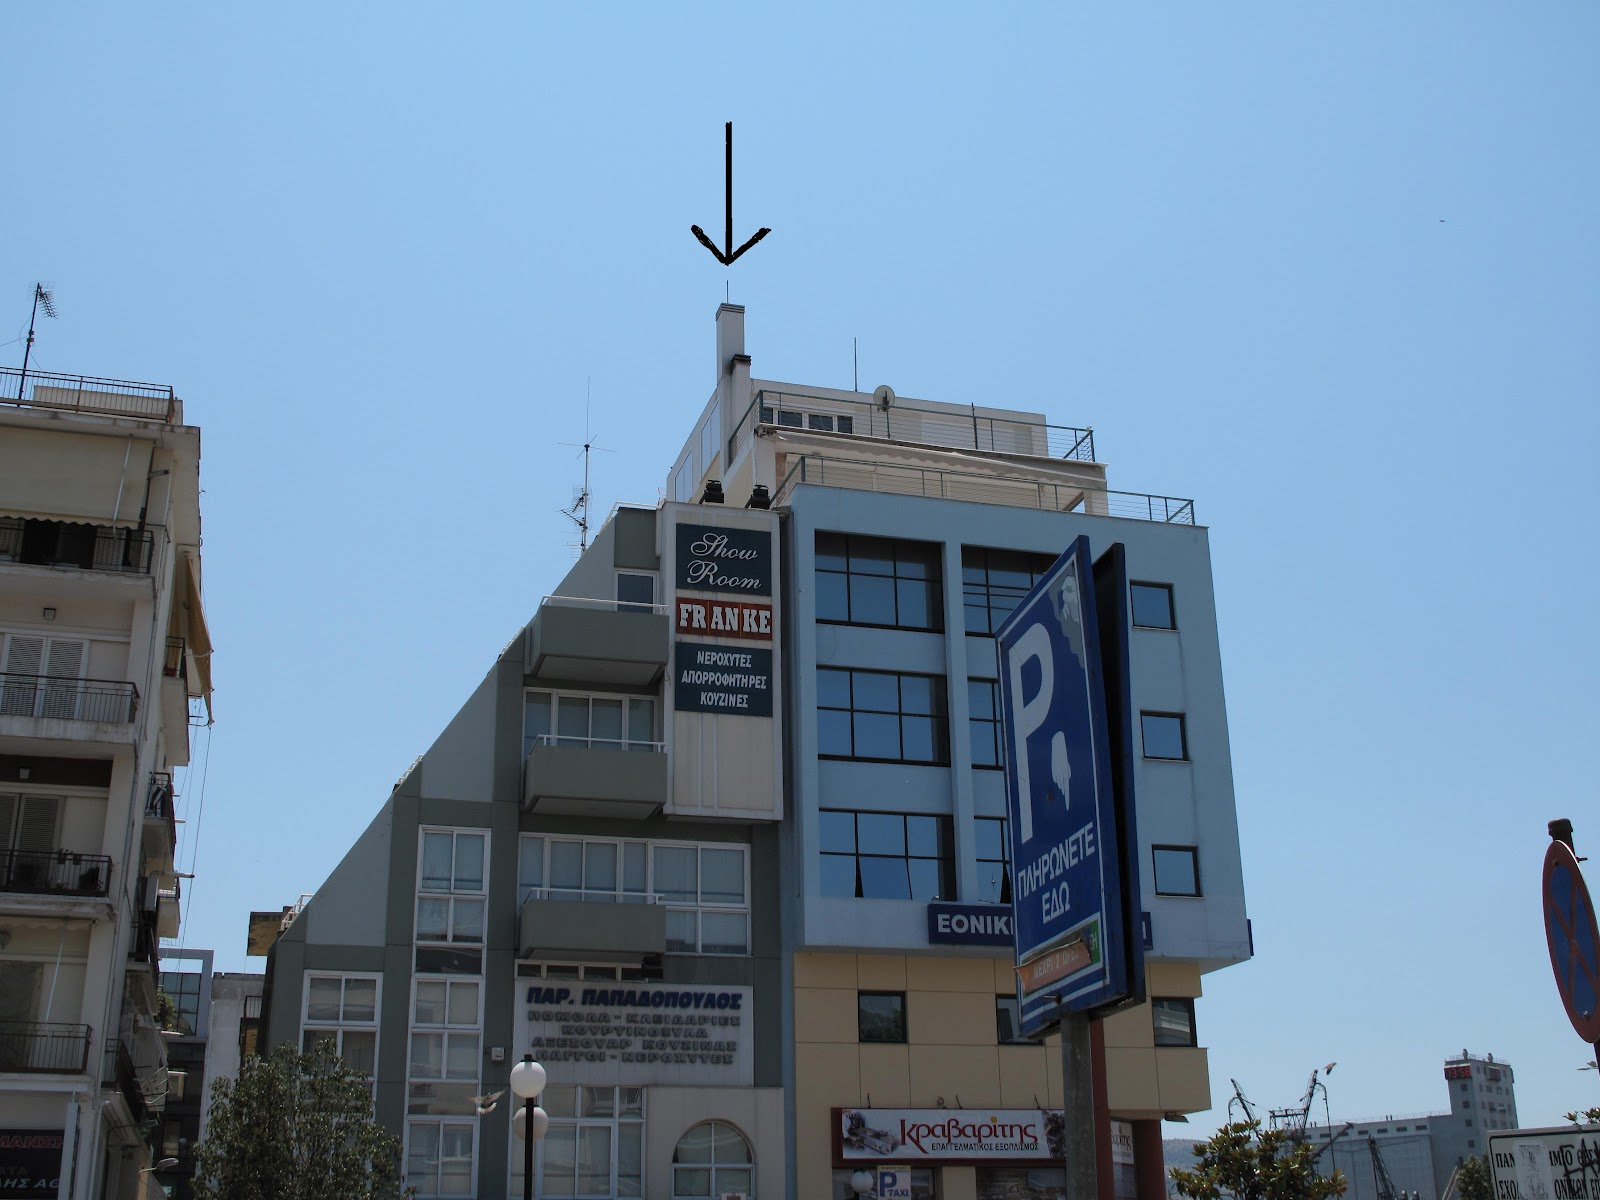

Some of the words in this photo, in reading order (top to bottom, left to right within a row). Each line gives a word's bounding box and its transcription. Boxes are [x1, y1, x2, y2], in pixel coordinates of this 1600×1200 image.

[690, 532, 758, 560] Show
[687, 559, 762, 589] Room
[679, 603, 771, 634] FRANKE
[697, 650, 752, 668] ΝΕΡΟΧΥΤΕΣ
[681, 669, 767, 690] ΑΠΟΡΡΟΦΗΤΗΡΕΣ
[700, 691, 749, 708] ΚΟΥΖΙΝΕΣ
[1009, 621, 1054, 845] P
[1017, 821, 1096, 901] ΠΛΗΡΩΝΕΤΕ
[1041, 881, 1071, 925] ΕΔΩ
[527, 987, 574, 1005] ΠΑΡ.
[581, 989, 743, 1010] ΠΑΠΑΔΟΠΟΥΛΟΣ
[528, 1011, 610, 1023] ΠΟΜΟΛΑ
[626, 1012, 741, 1026] ΚΛΕΙΔΑΡΙΕΣ
[561, 1025, 708, 1038] ΚΟΥΡΤΙΝΟΞΥΛΑ
[532, 1037, 633, 1049] ΑΞΕΣΟΥΑΡ
[642, 1039, 737, 1052] ΚΟΥΖΙΝΑΣ
[621, 1051, 734, 1065] ΝΕΡΟΧΥΤΕΣ
[888, 1189, 909, 1197] TAXI
